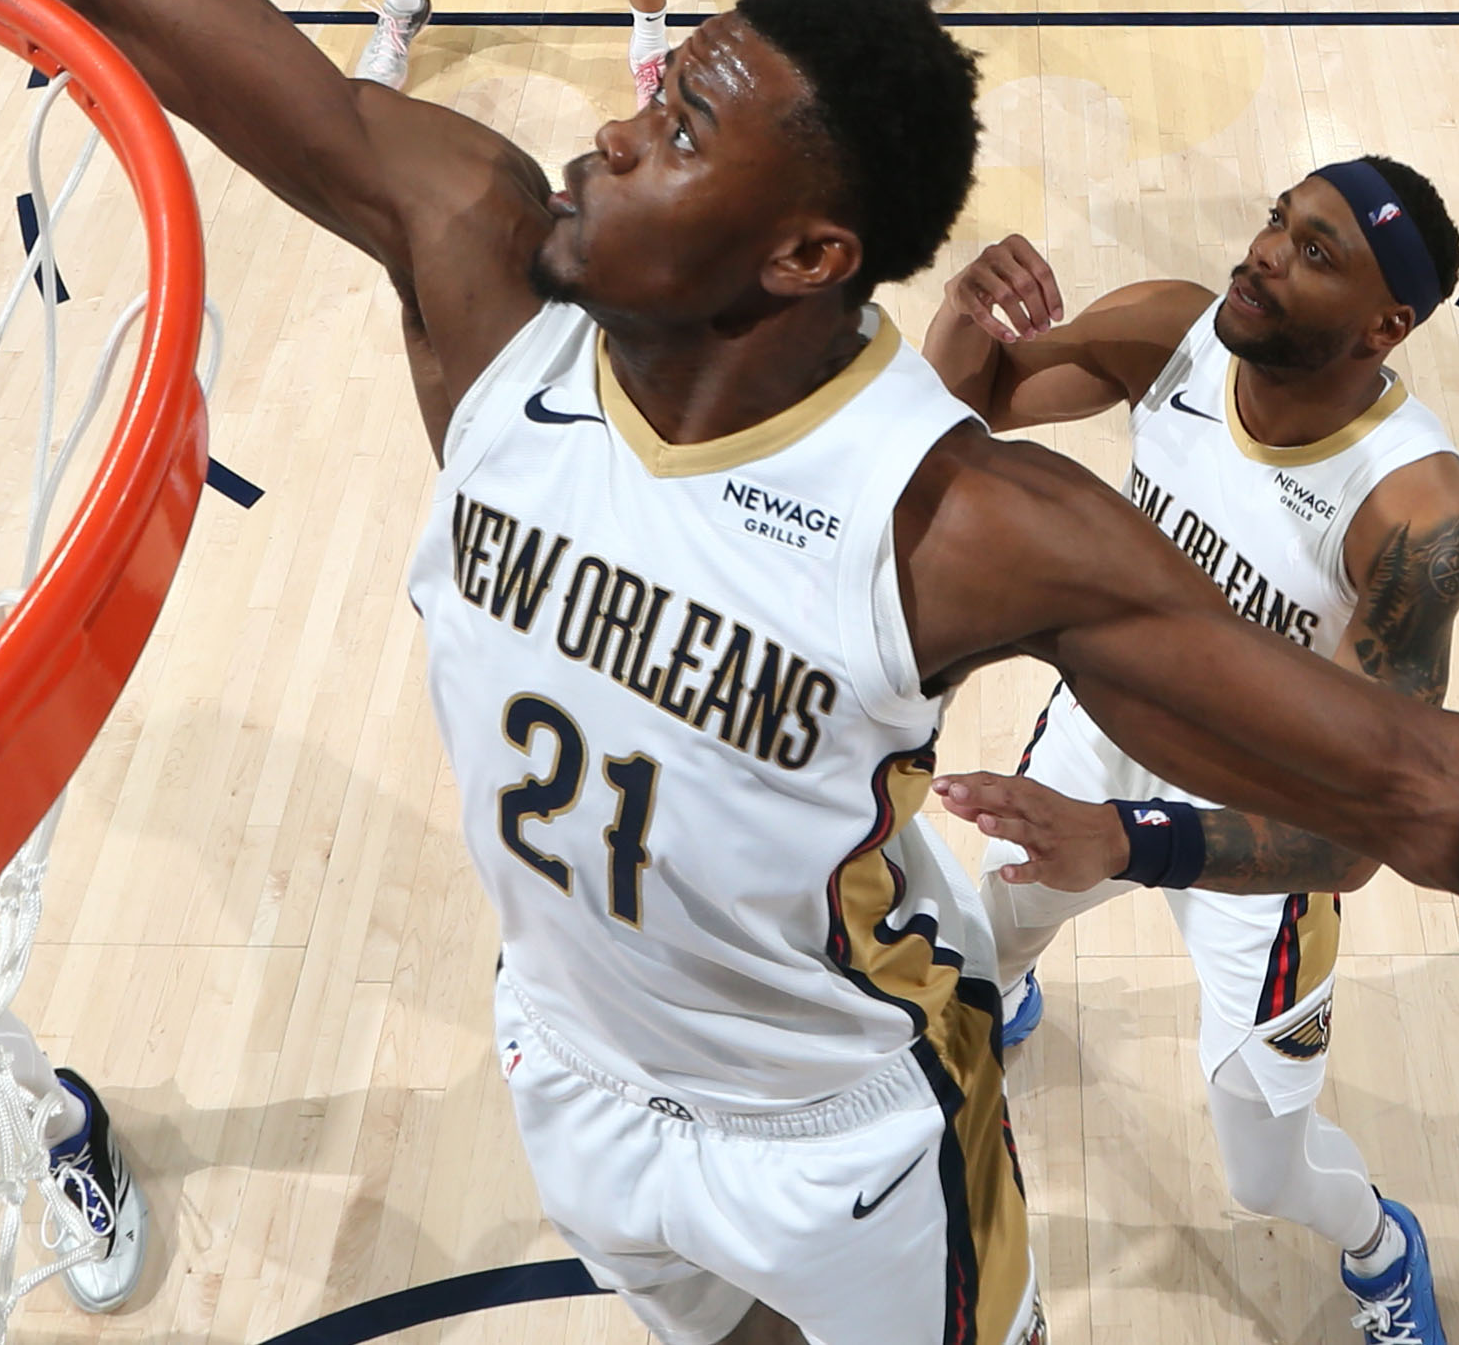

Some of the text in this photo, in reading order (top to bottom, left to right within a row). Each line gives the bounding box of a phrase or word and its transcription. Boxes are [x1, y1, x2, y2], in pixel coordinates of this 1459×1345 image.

[722, 478, 841, 541] NEWAGE
[1274, 471, 1336, 520] NEWAGE
[1280, 496, 1314, 522] GRILLS
[744, 518, 808, 549] GRILLS
[556, 555, 838, 771] ORLEANS
[498, 691, 663, 929] 21
